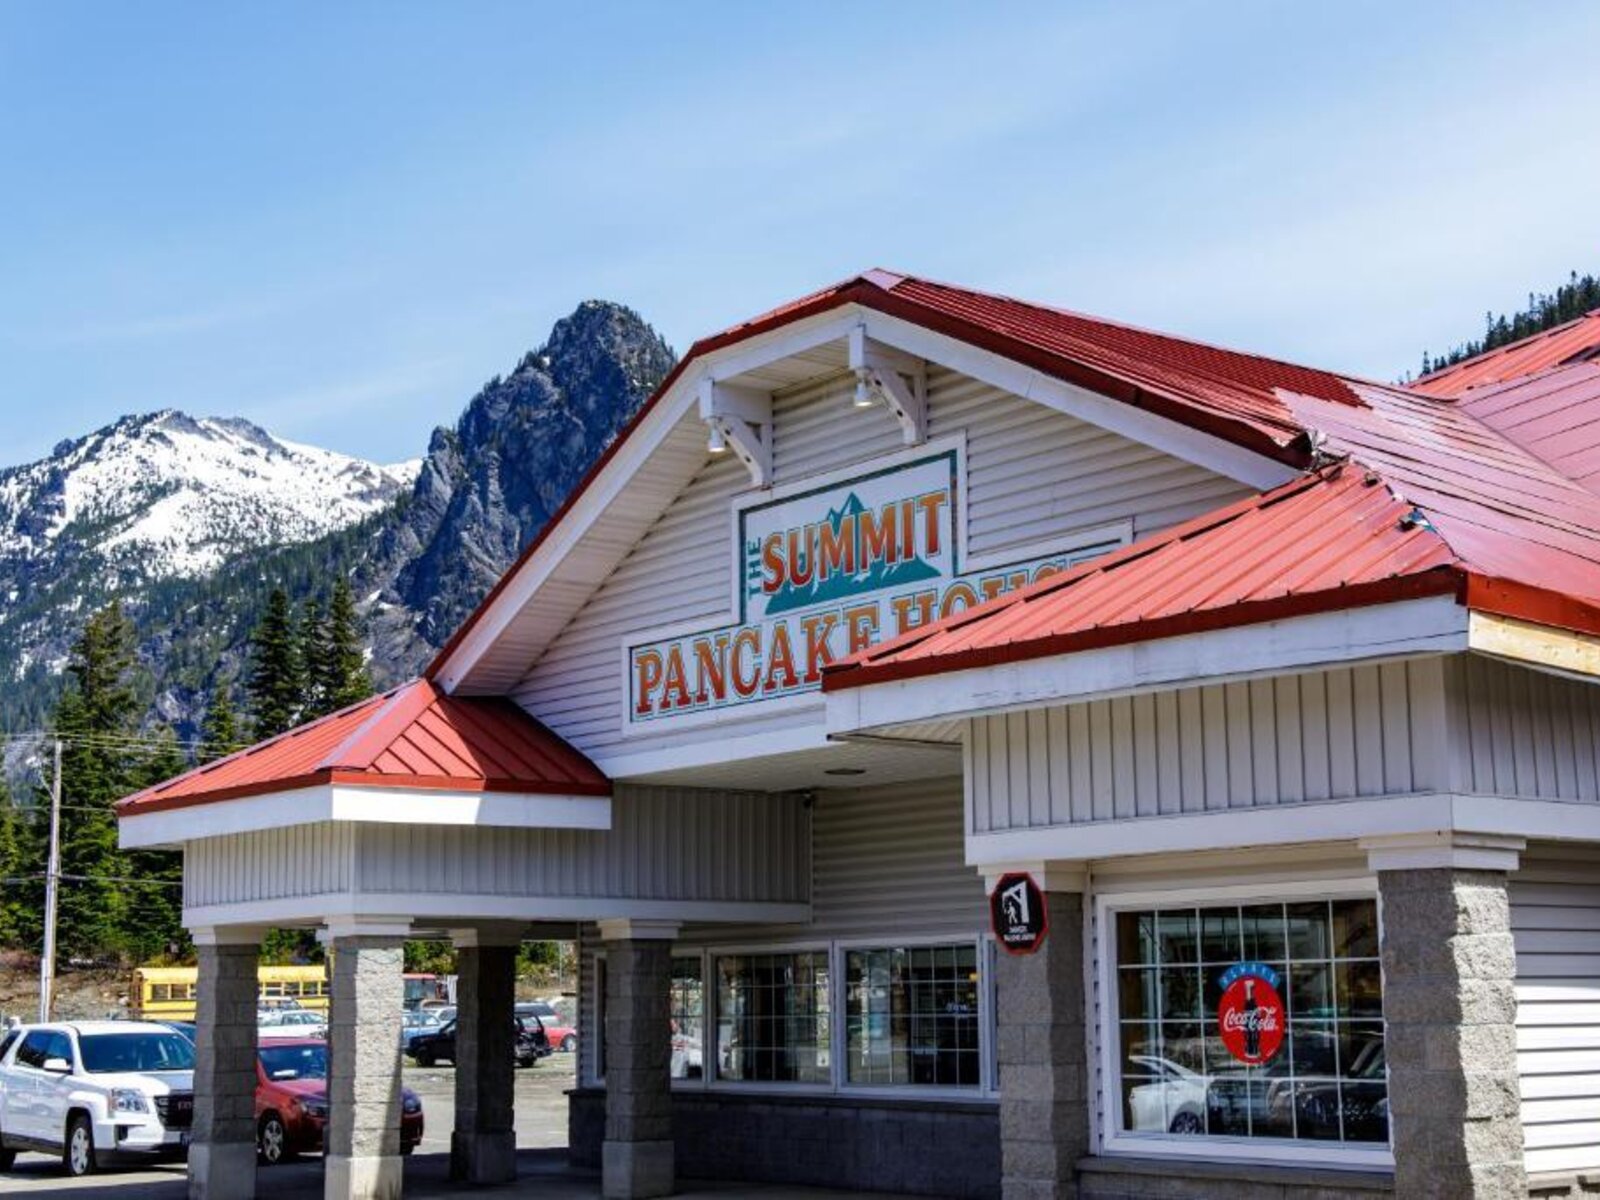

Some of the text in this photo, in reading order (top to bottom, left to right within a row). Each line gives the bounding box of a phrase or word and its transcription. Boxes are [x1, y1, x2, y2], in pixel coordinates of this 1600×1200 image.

[747, 536, 762, 600] THE
[762, 489, 947, 594] SUMMIT
[635, 601, 879, 715] PANCAKE
[1223, 1006, 1277, 1032] Coca-Cola
